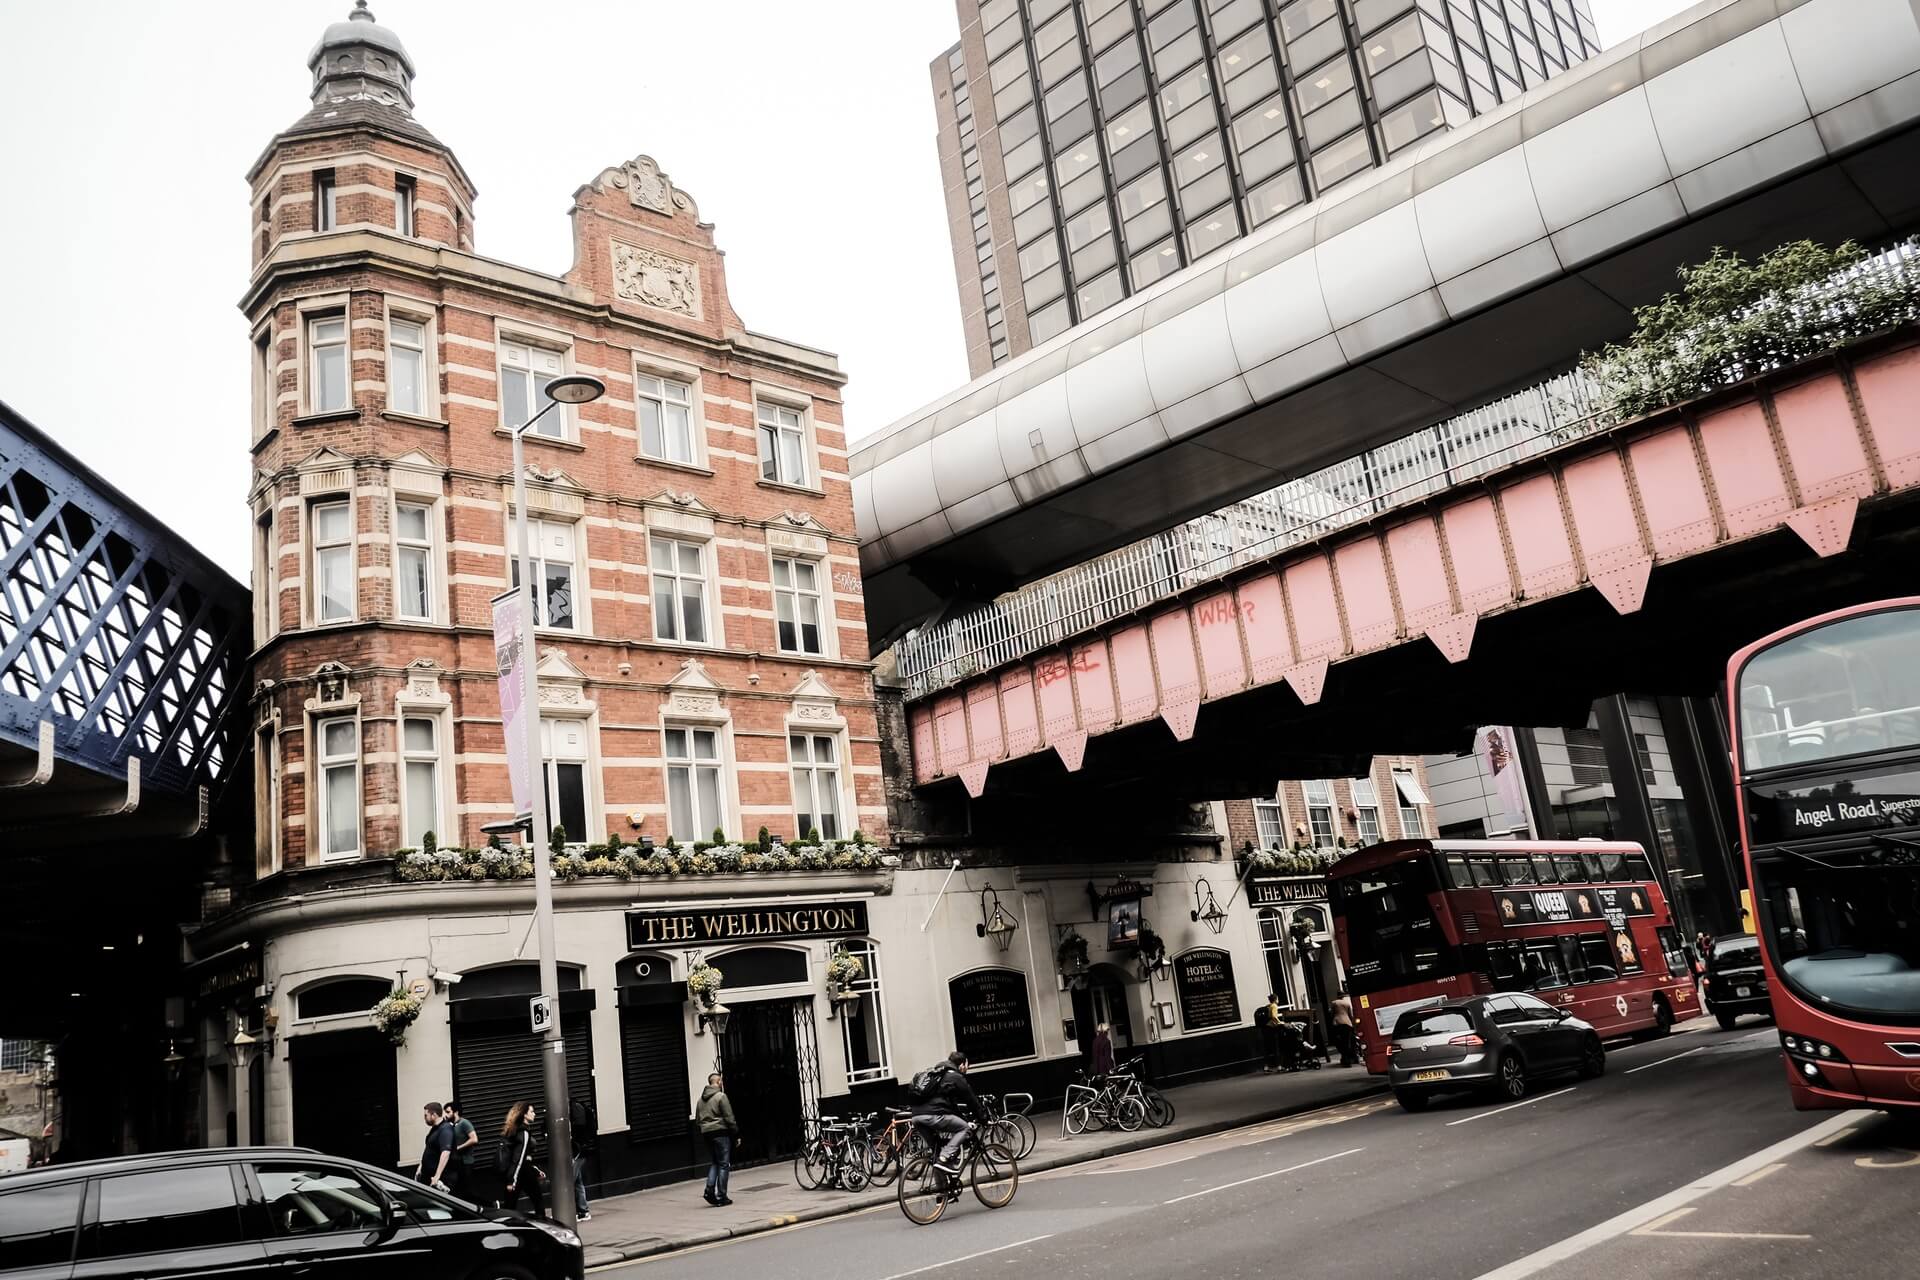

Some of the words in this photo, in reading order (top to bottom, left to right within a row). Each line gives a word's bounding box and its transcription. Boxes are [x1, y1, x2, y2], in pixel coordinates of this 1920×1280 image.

[1795, 805, 1835, 827] Angel
[1838, 799, 1877, 820] Road
[1254, 885, 1281, 902] THE
[1534, 892, 1568, 914] QUEEN
[643, 916, 696, 942] THE
[700, 908, 856, 937] WELLINGTON
[1183, 954, 1193, 963] THE
[1193, 951, 1223, 961] WELLINGTON
[1186, 964, 1214, 977] HOTEL
[962, 1022, 997, 1035] FRESH
[997, 1019, 1026, 1031] FOOD
